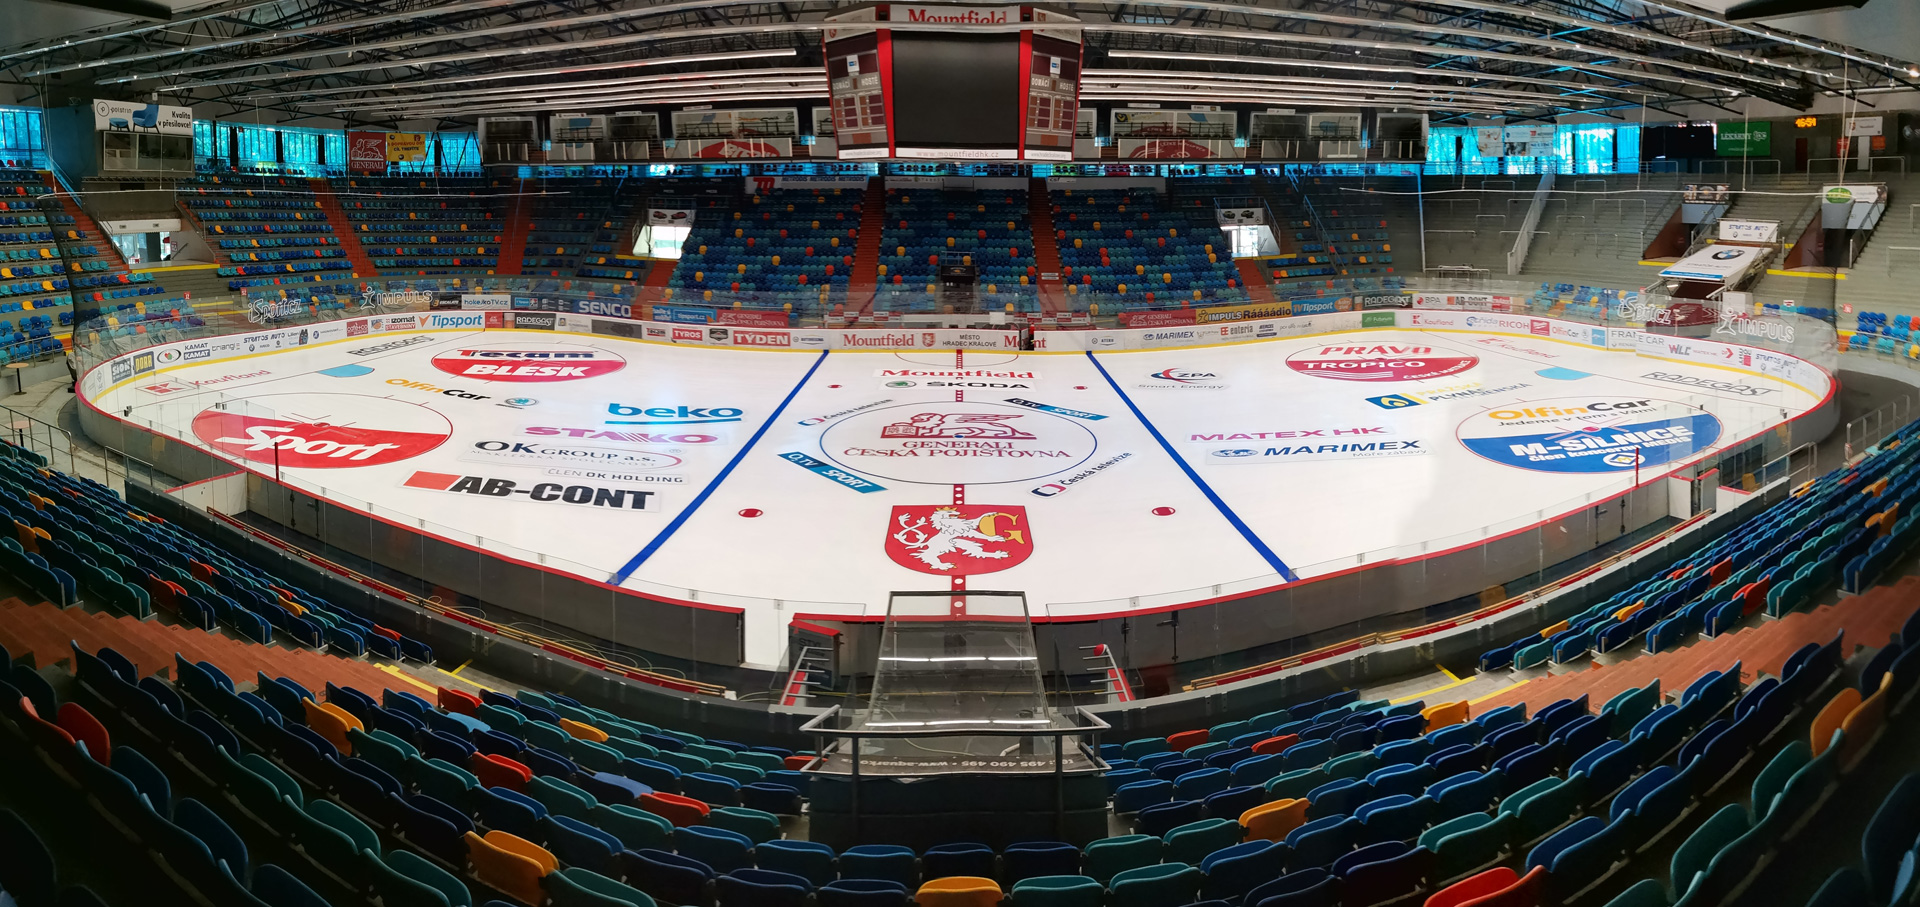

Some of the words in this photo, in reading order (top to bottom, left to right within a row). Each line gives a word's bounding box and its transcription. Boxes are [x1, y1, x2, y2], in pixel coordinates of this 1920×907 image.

[351, 161, 384, 169] GENERALI
[377, 290, 433, 305] IMPULS
[1364, 295, 1411, 306] RADEGAST
[1425, 296, 1441, 304] BPA
[579, 300, 631, 318] SENCO
[431, 315, 483, 328] Tipsport
[516, 316, 554, 326] RADEGAST
[1208, 311, 1242, 320] IMPULS
[1424, 318, 1454, 326] Kaufland
[1499, 320, 1529, 329] RICOH
[674, 330, 701, 339] TYROS
[1155, 331, 1194, 340] MARIMEX
[1738, 318, 1794, 343] IMPULS
[243, 335, 269, 343] STRATOS
[271, 332, 285, 340] AUTO
[735, 332, 789, 345] TÝDEN
[843, 333, 914, 346] Mountfield
[184, 350, 209, 360] KAMAT
[462, 364, 591, 376] BLESK
[1303, 360, 1426, 369] TROPICO
[189, 369, 272, 387] Kaufland
[881, 369, 1034, 379] Mountfield
[385, 378, 491, 400] OlfinCar
[1641, 371, 1782, 396] RADEGAST
[607, 402, 743, 418] beko
[1050, 407, 1097, 419] SPORT
[1488, 399, 1652, 420] OlfinCar
[1498, 417, 1559, 427] Jedeme
[1576, 412, 1607, 420] tom
[1190, 429, 1327, 441] MATEX
[1332, 426, 1388, 436] HK
[215, 425, 400, 461] Sport
[902, 441, 1014, 449] GENERALI
[1509, 425, 1695, 457] M-SILNICE
[475, 441, 539, 453] OK
[541, 448, 619, 460] GROUP
[844, 447, 919, 457] ČESKÁ
[1263, 440, 1421, 456] MARIMEX
[586, 471, 606, 479] OK
[612, 474, 683, 483] HOLDING
[822, 469, 873, 489] SPORT
[1059, 469, 1096, 486] Česká
[448, 475, 655, 510] AB-CONT
[961, 760, 987, 768] 495
[990, 760, 1016, 768] 490
[1020, 760, 1046, 768] 495
